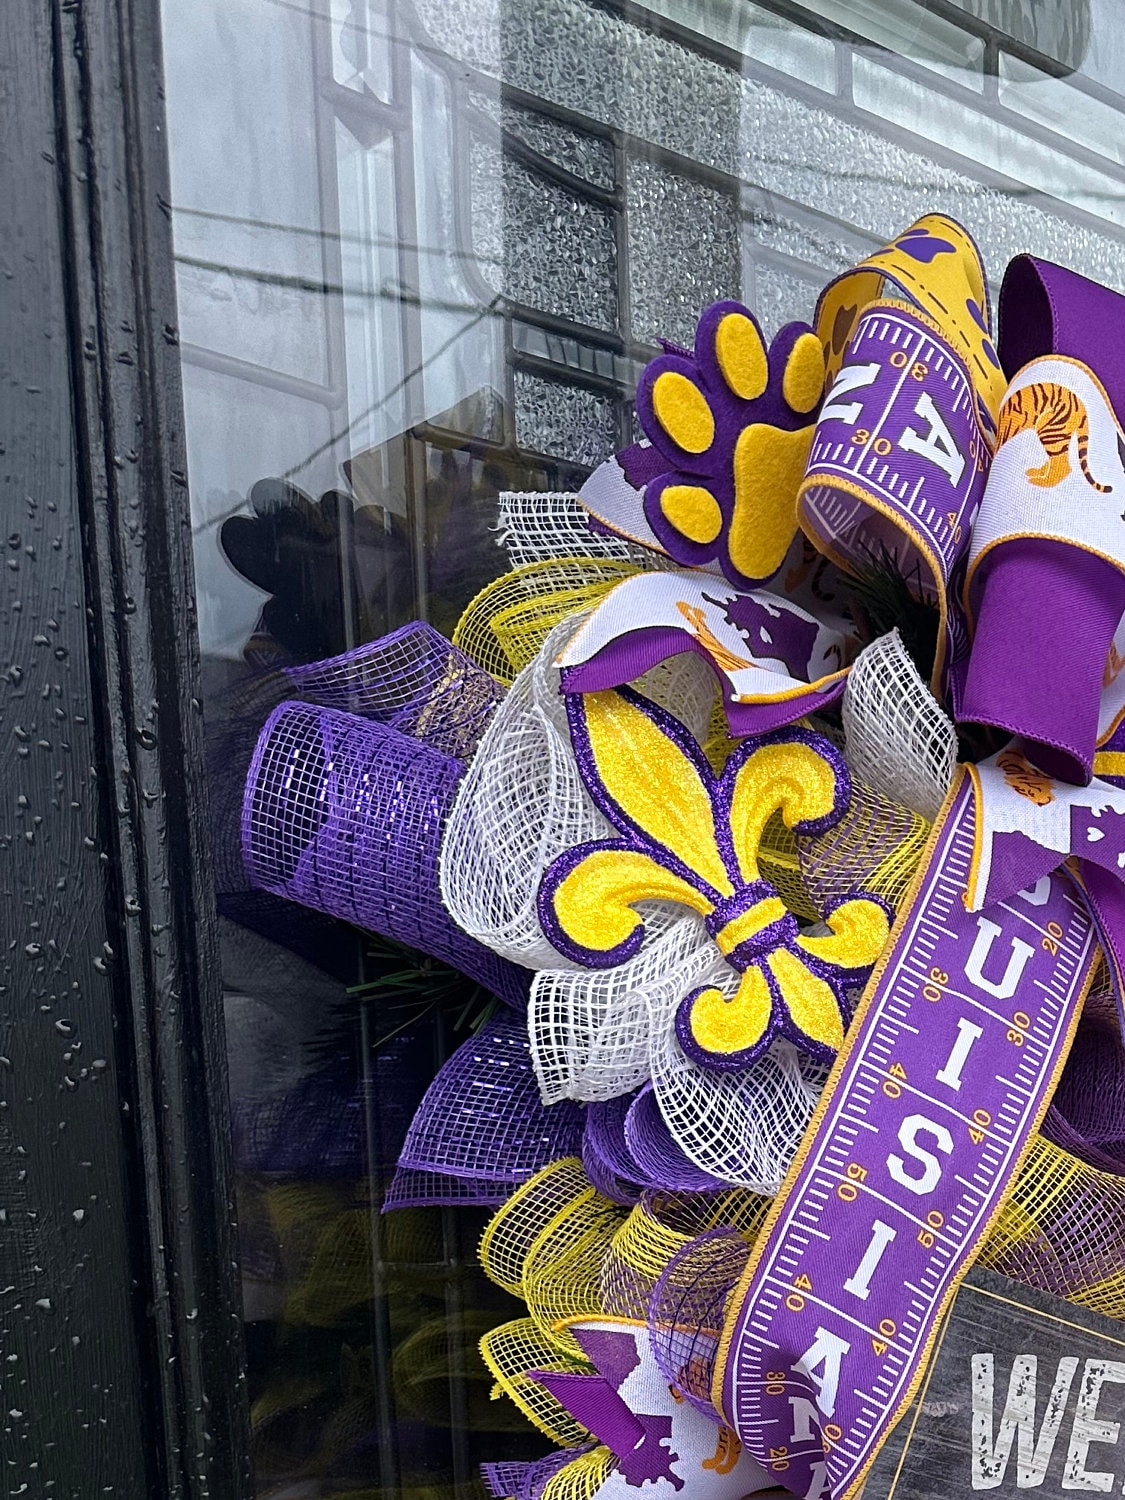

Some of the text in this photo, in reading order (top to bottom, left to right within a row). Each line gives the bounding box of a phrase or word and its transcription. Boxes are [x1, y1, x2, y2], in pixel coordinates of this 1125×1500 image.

[1041, 921, 1063, 957] 20
[922, 967, 949, 1002] 30
[1006, 1011, 1030, 1047] 30
[882, 1062, 907, 1099] 40
[968, 1108, 992, 1145] 40
[837, 1162, 868, 1202] 50
[917, 1210, 944, 1249] 50
[785, 1274, 812, 1312] 40
[872, 1318, 896, 1357] 40
